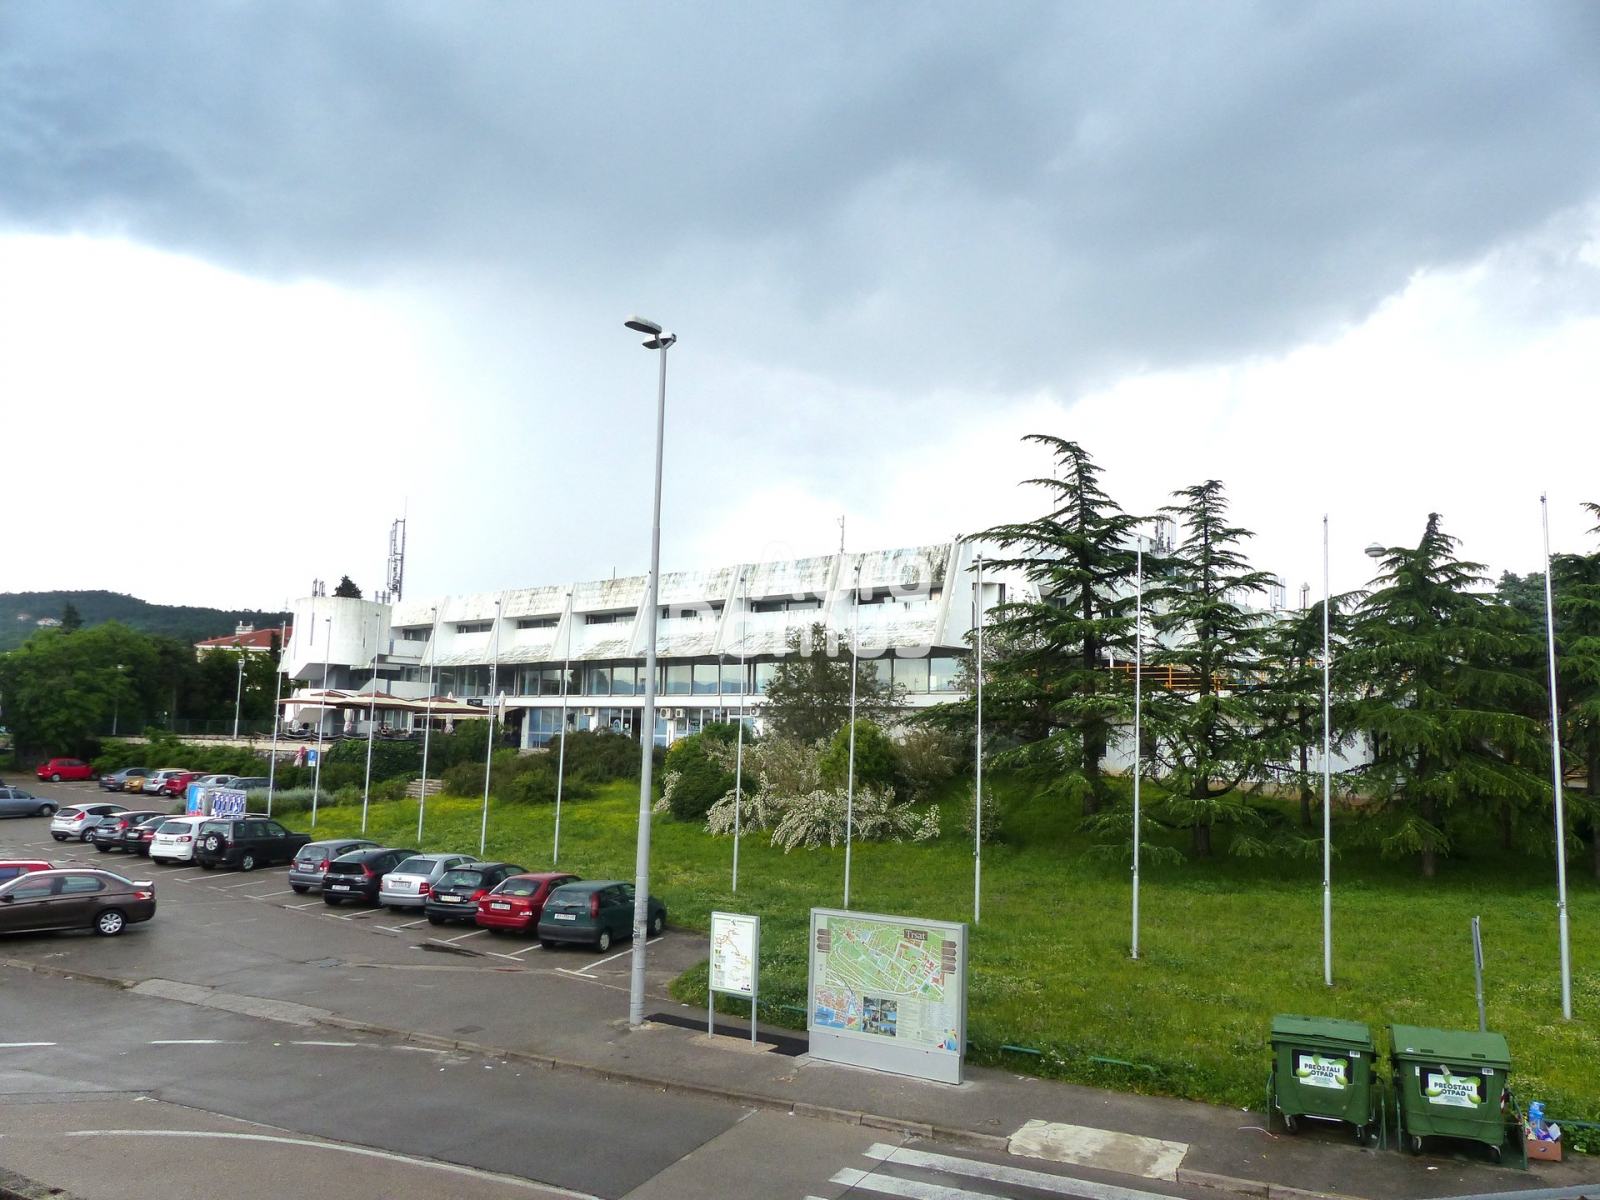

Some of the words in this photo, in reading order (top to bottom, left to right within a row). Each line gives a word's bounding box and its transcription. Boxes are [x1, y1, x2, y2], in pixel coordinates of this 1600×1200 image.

[906, 930, 925, 940] Trsat
[1304, 1063, 1340, 1073] PREOSTALI
[1310, 1069, 1334, 1078] OTPAD
[1440, 1088, 1466, 1097] OTPAD
